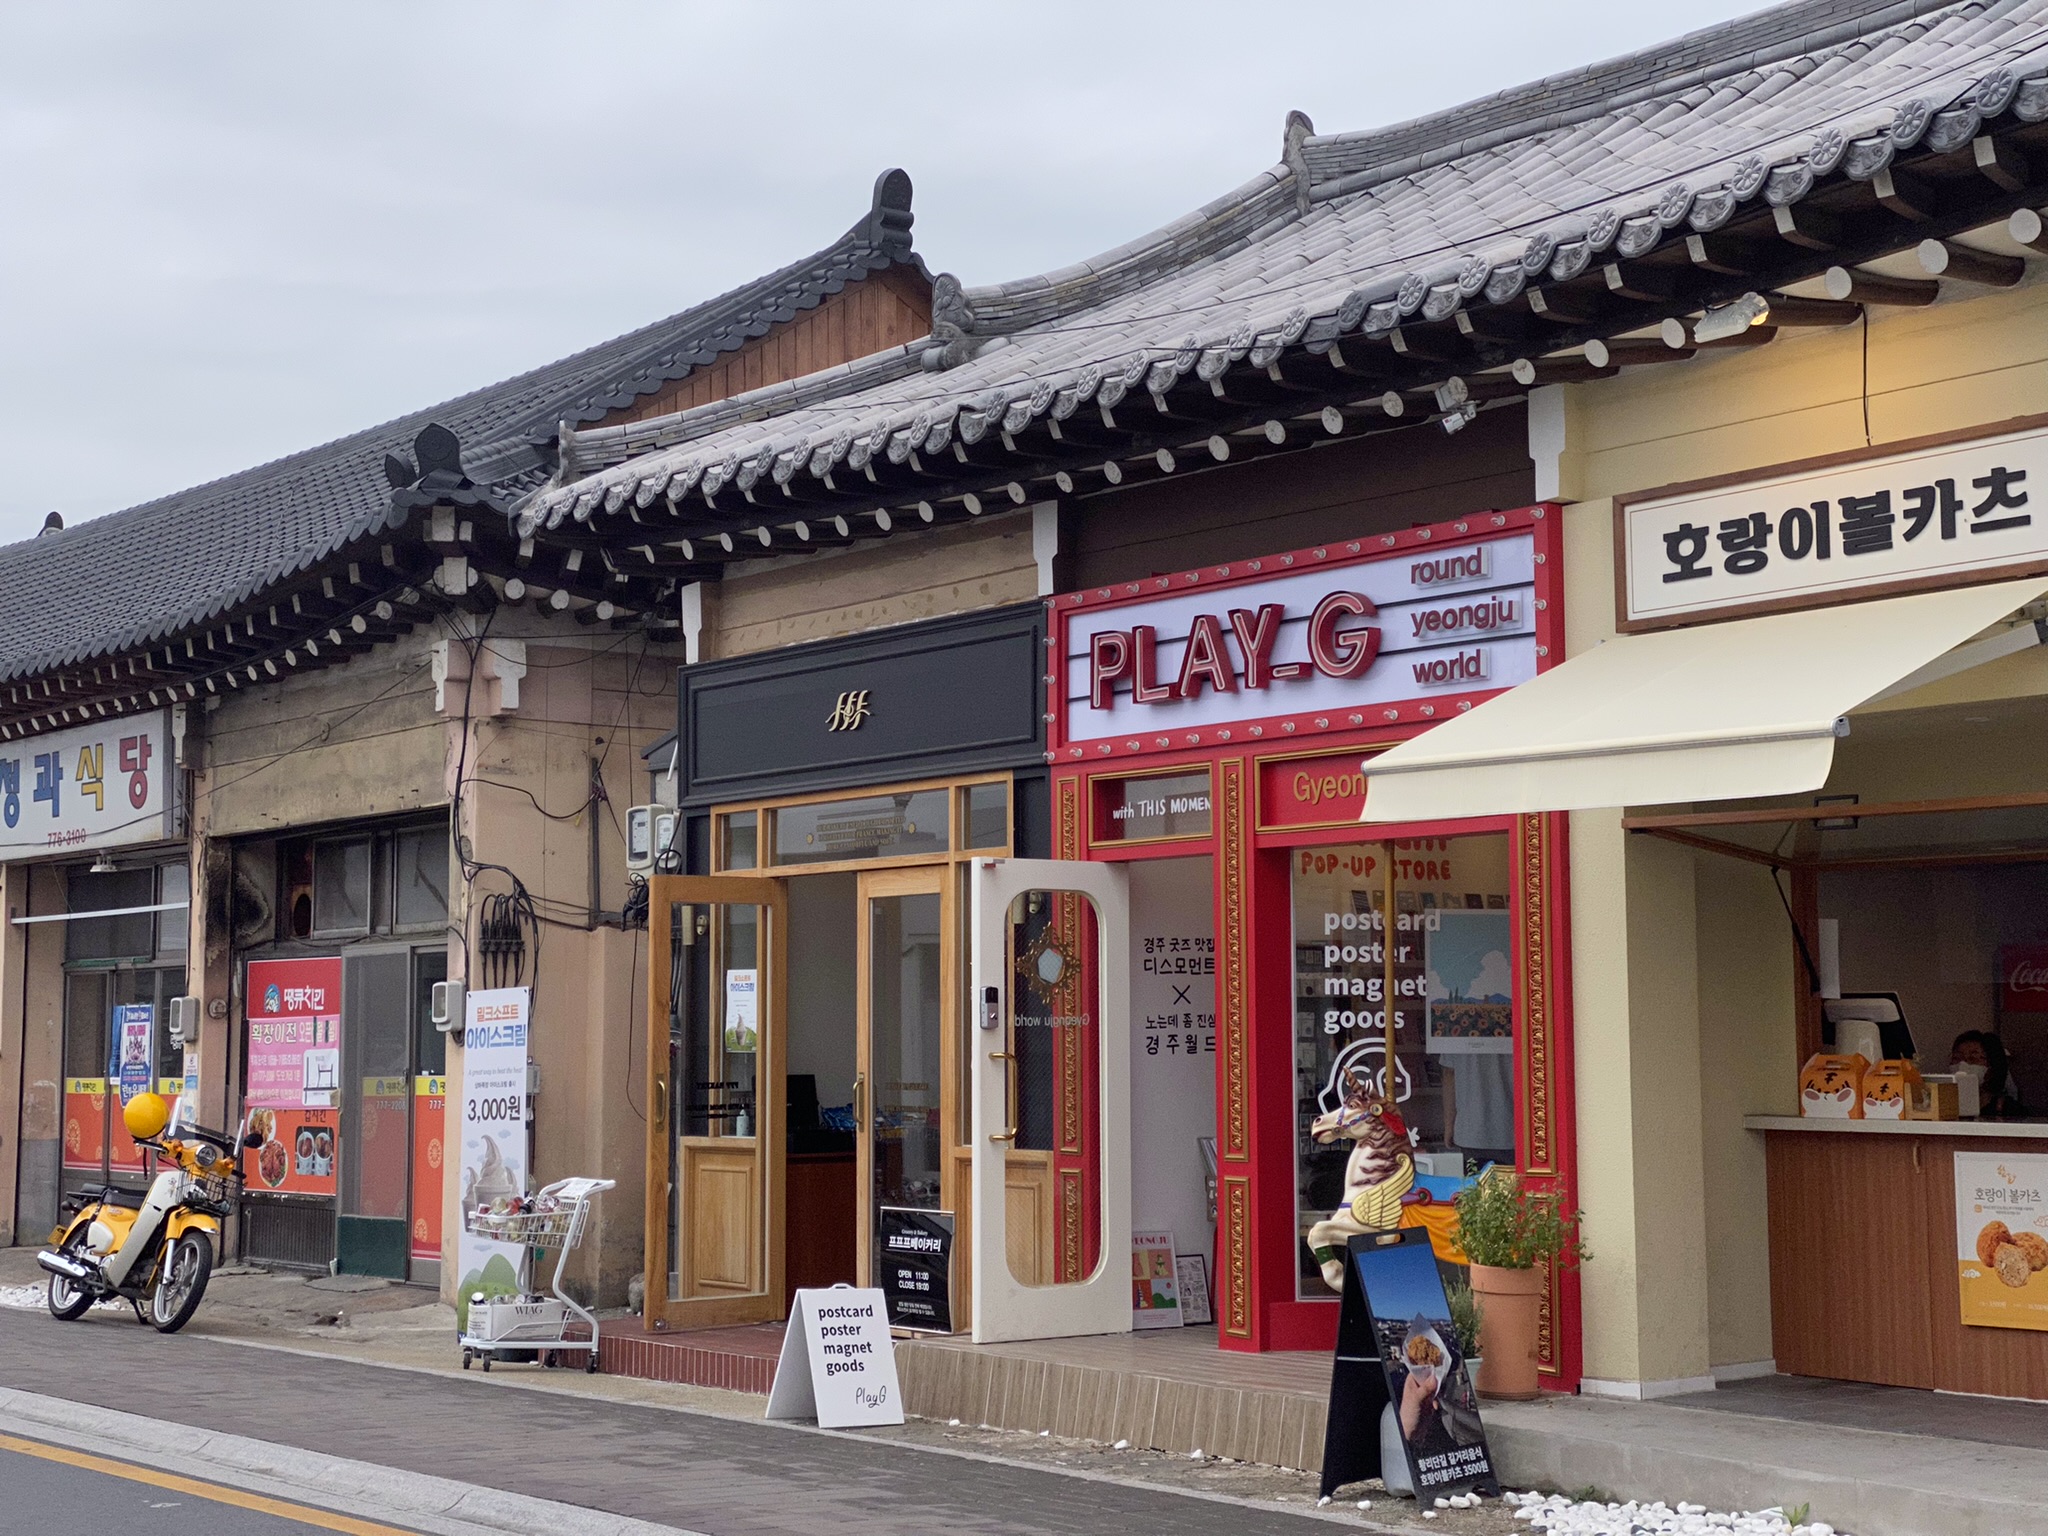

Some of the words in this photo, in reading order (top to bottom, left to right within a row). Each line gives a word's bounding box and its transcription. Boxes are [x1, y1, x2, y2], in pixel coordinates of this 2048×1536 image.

[1662, 466, 2031, 583] 호랑이볼카츠
[1411, 547, 1482, 584] round
[1410, 595, 1513, 637] yeongju
[1412, 648, 1481, 683] world
[1113, 802, 1134, 819] with
[1137, 799, 1166, 817] THIS
[1324, 910, 1440, 935] postard
[1144, 938, 1165, 953] 경주
[1169, 938, 1191, 952] 굿즈
[1194, 938, 1215, 953] 맛집
[1143, 957, 1215, 975] 디스모먼트
[1145, 1014, 1178, 1029] 노는데
[251, 1022, 297, 1044] 확장이전
[466, 1024, 527, 1049] 아이스크림
[467, 1095, 521, 1124] 3,000원
[1974, 1188, 2006, 1203] 호랑이
[2009, 1189, 2042, 1203] 볼카츠
[888, 1236, 942, 1252] 프프프베이커리
[898, 1269, 912, 1278] OPEN
[898, 1280, 915, 1290] CLOSE
[818, 1305, 873, 1321] postcard
[821, 1324, 861, 1339] poster
[824, 1342, 872, 1357] magnet
[826, 1359, 865, 1376] goods
[856, 1385, 887, 1408] PlayG
[1418, 1454, 1448, 1472] 황리단길
[1447, 1446, 1483, 1465] 길거리음식
[1420, 1466, 1463, 1486] 호랑이볼카츠
[1463, 1459, 1489, 1476] 3500원
